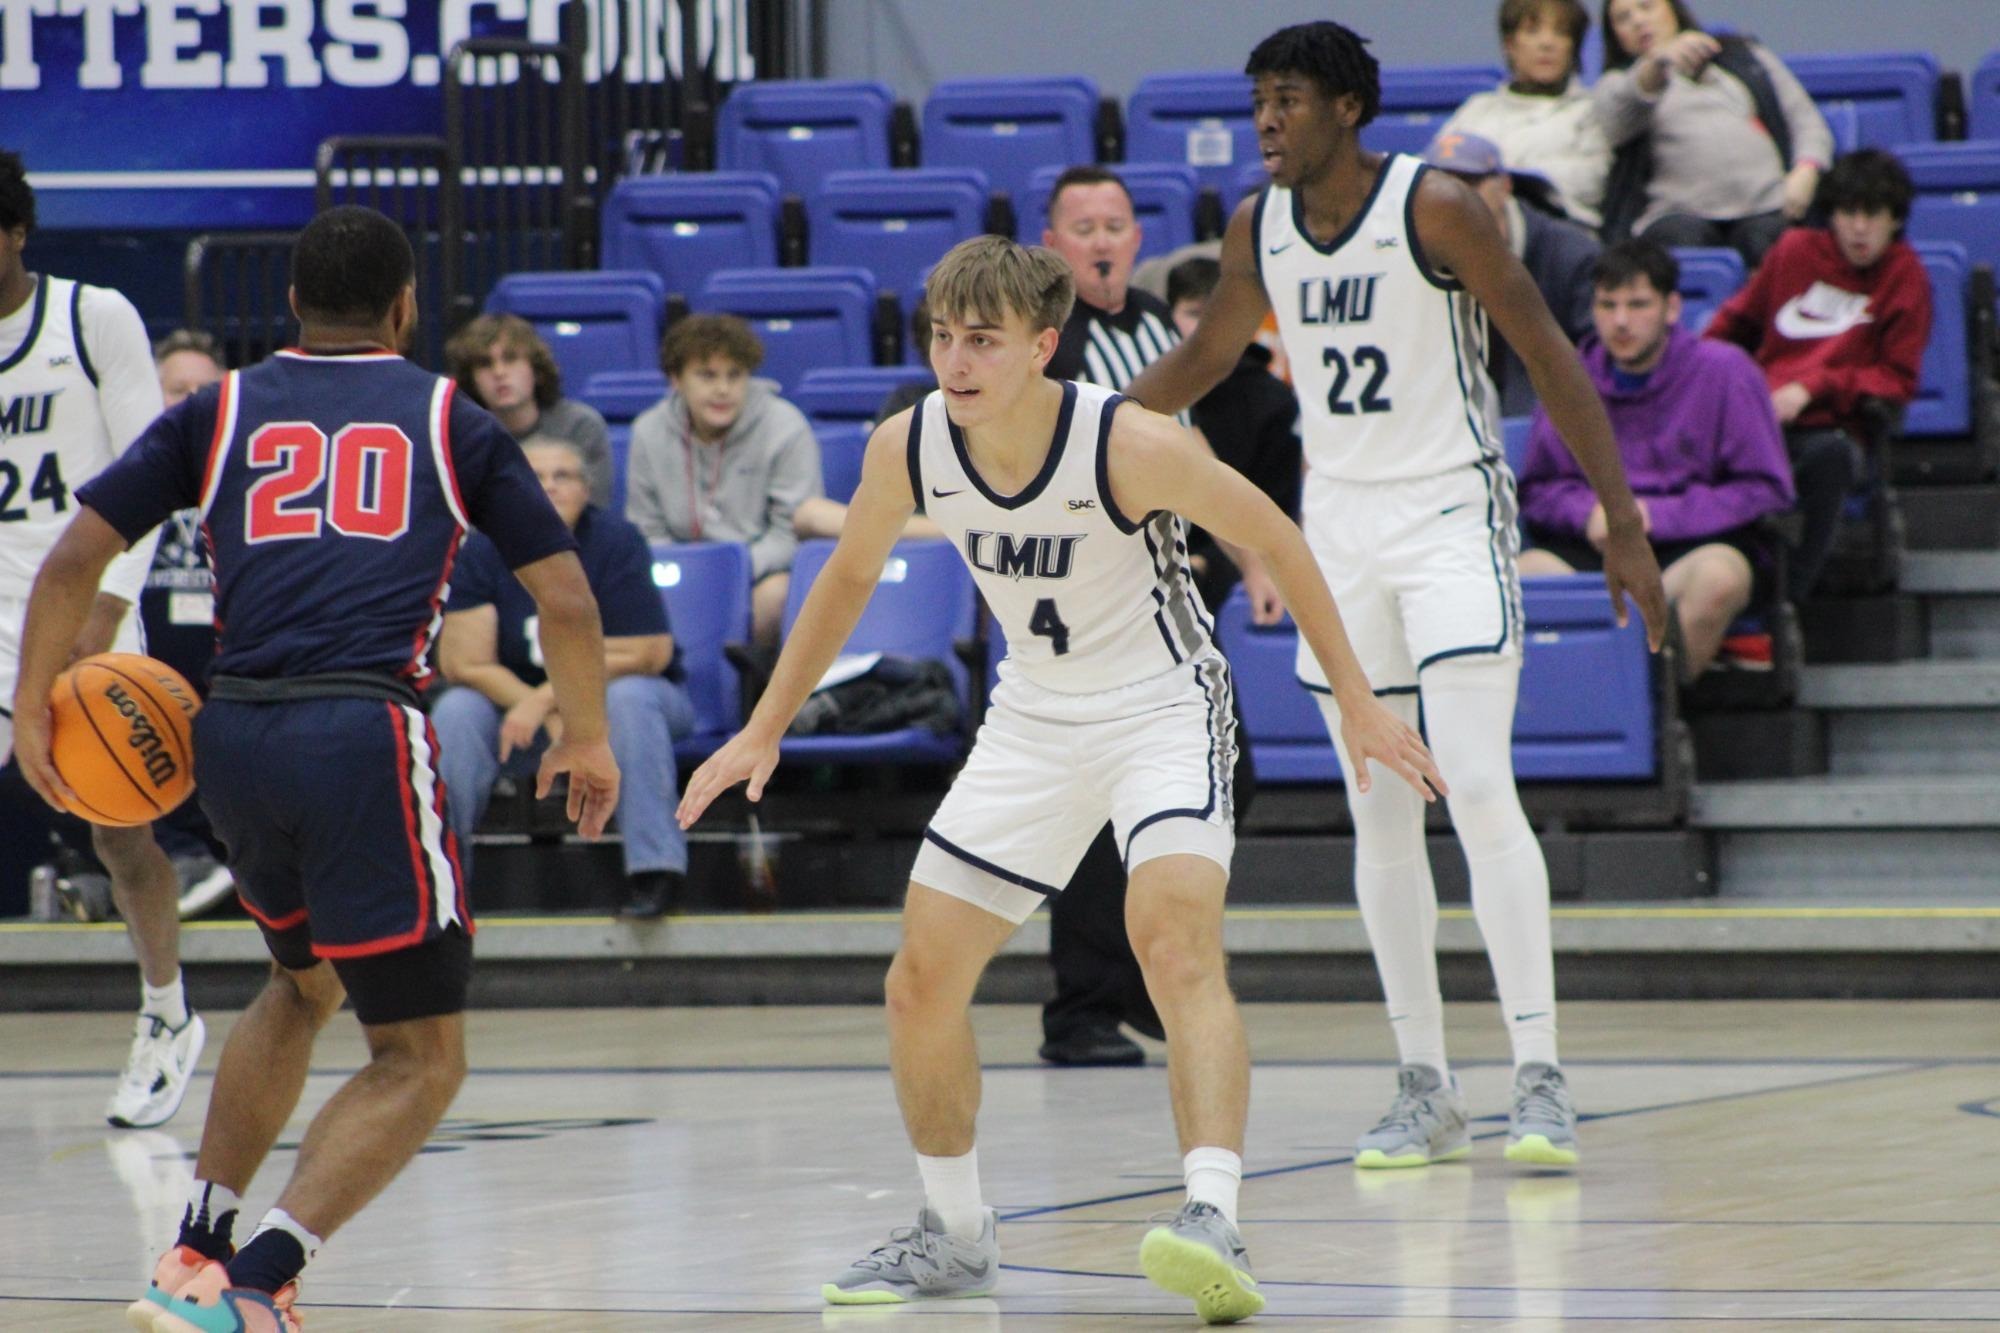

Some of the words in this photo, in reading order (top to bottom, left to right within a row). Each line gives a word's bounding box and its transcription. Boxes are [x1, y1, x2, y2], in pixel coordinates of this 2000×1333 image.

[1299, 272, 1387, 328] LMU
[1323, 345, 1392, 415] 22
[0, 451, 67, 521] 24
[244, 421, 414, 545] 20
[1067, 499, 1096, 511] SAC
[965, 528, 1088, 582] LMU
[1028, 598, 1070, 657] 4
[105, 681, 177, 788] Wilson
